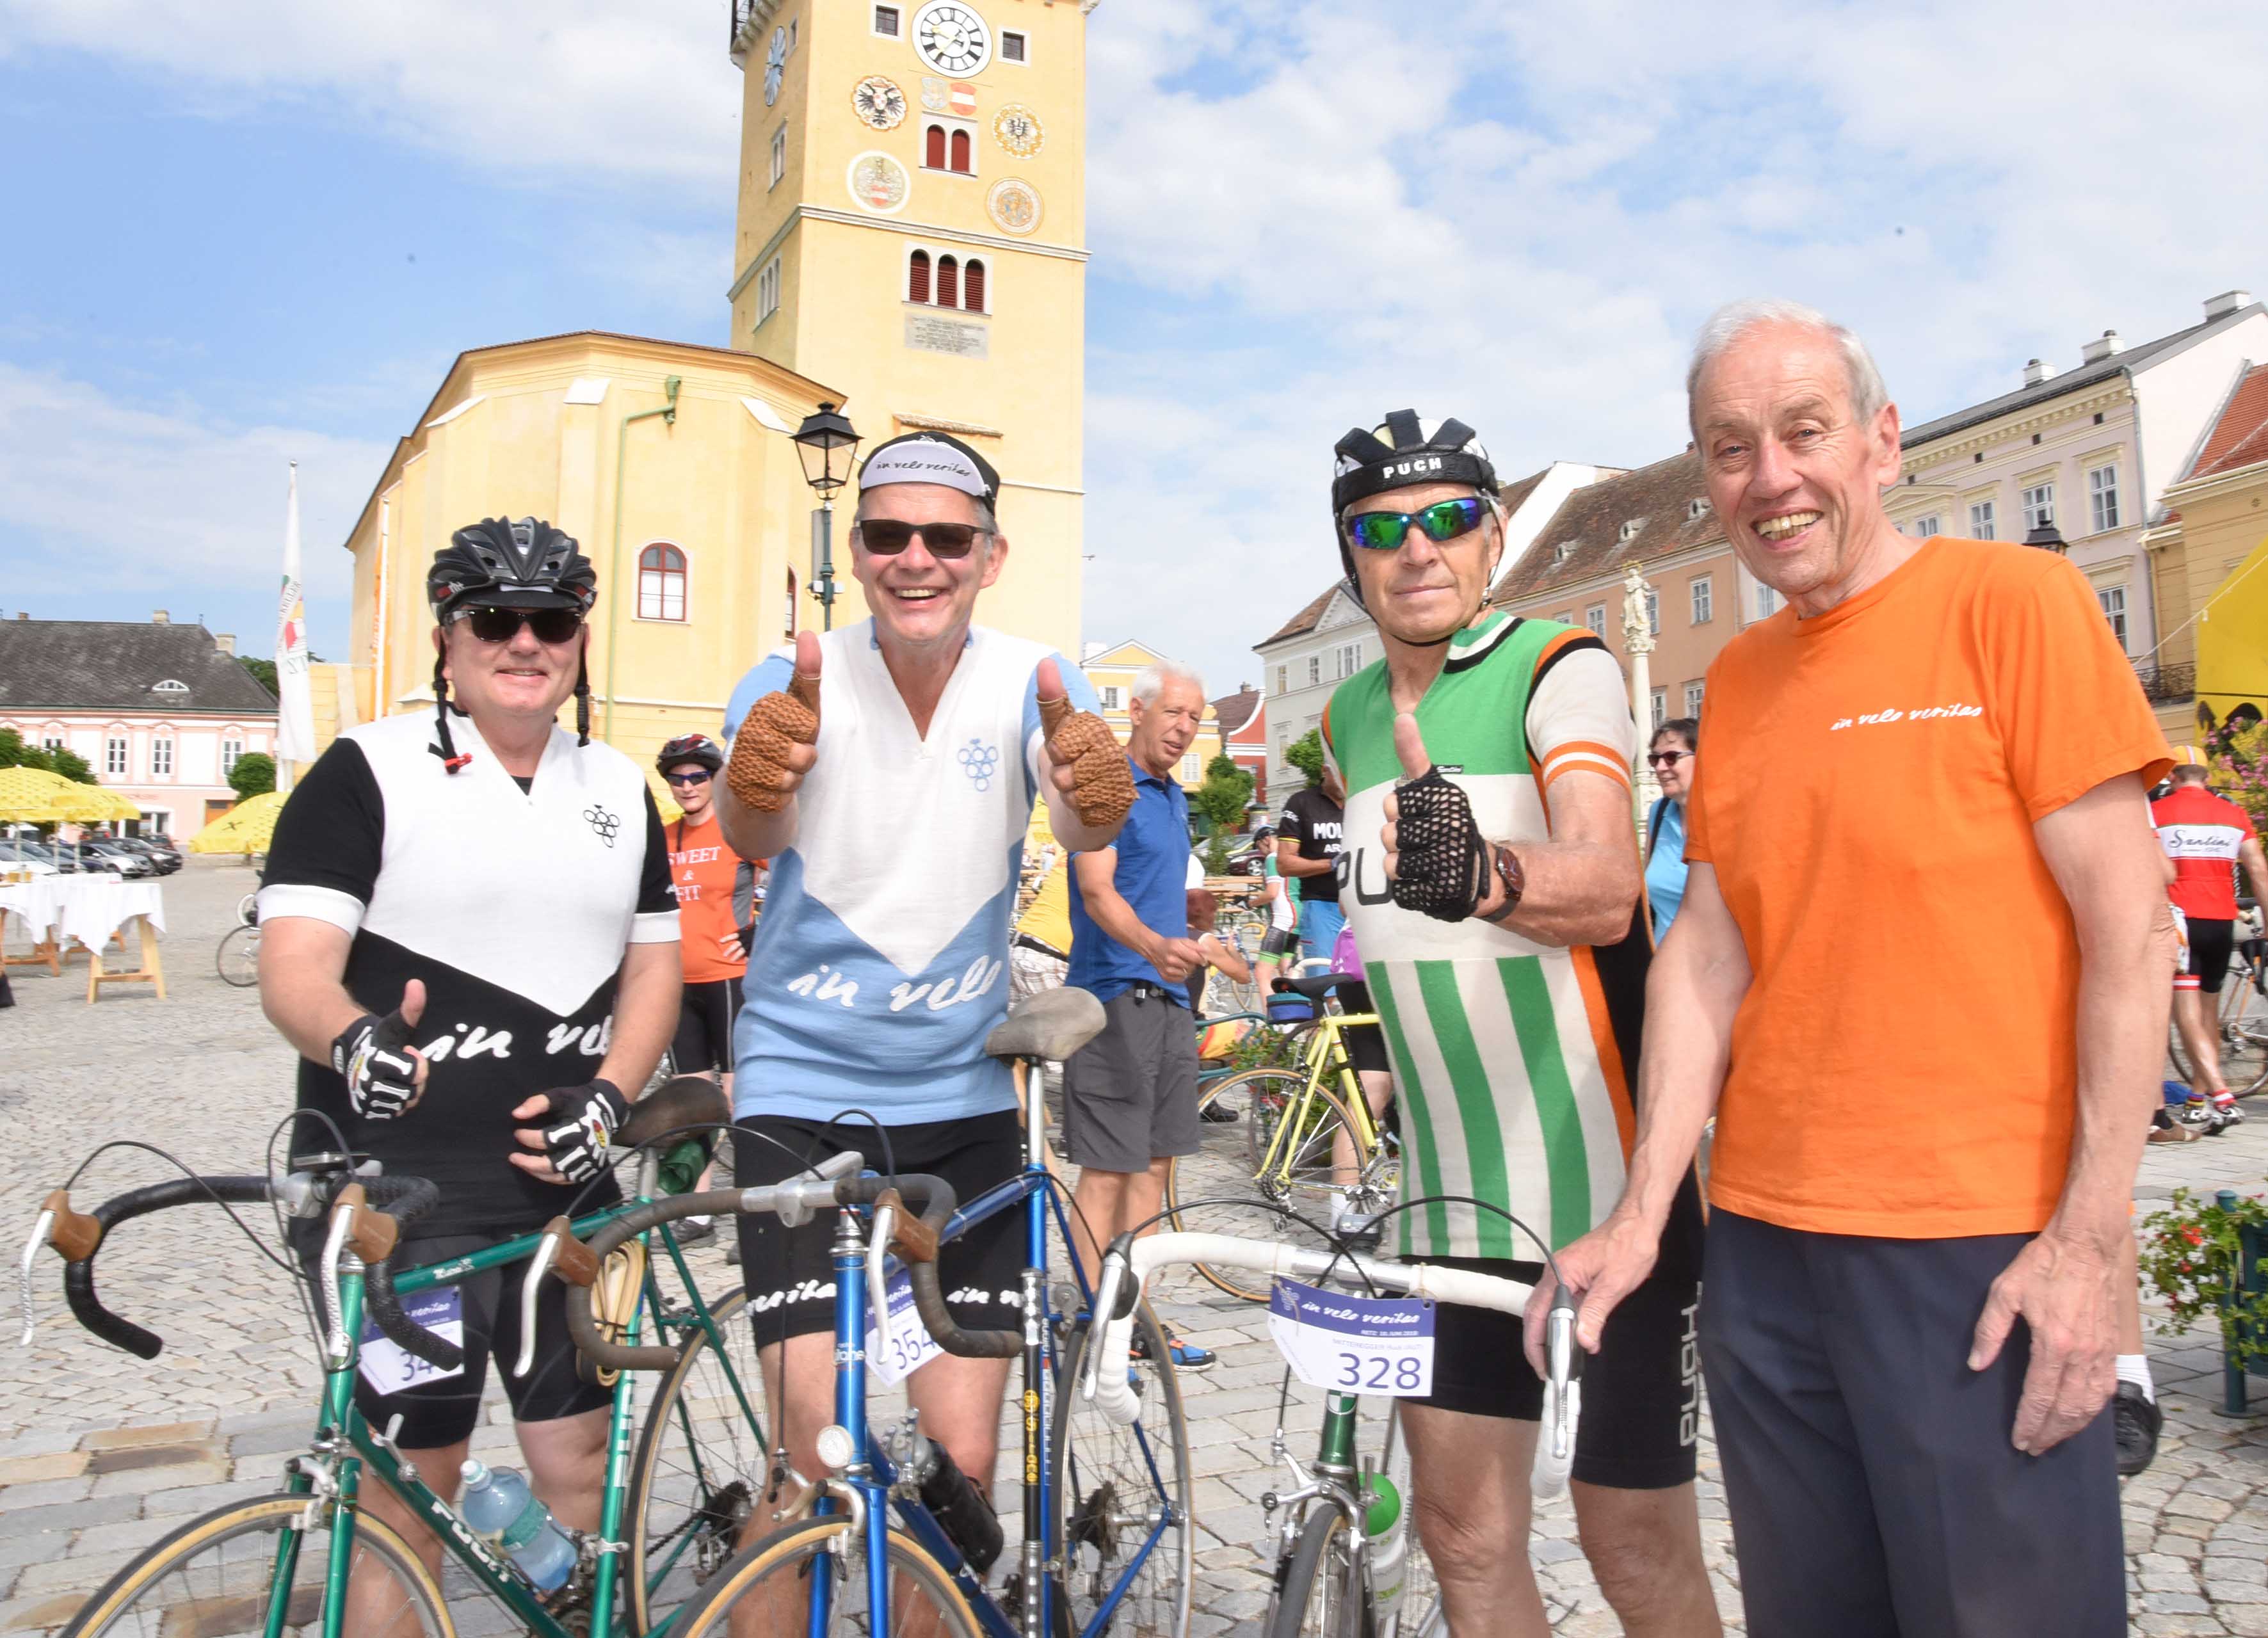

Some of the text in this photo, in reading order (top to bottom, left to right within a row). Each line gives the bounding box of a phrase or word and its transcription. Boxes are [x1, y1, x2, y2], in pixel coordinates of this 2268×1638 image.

[876, 460, 971, 477] in velo veritas
[1382, 457, 1443, 479] PUCH
[1830, 703, 1982, 731] in velo veritas
[668, 846, 722, 866] SWEET
[675, 885, 702, 903] FIT
[787, 965, 859, 1007] in
[1301, 1301, 1420, 1324] in velo veritas
[1338, 1353, 1420, 1390] 328
